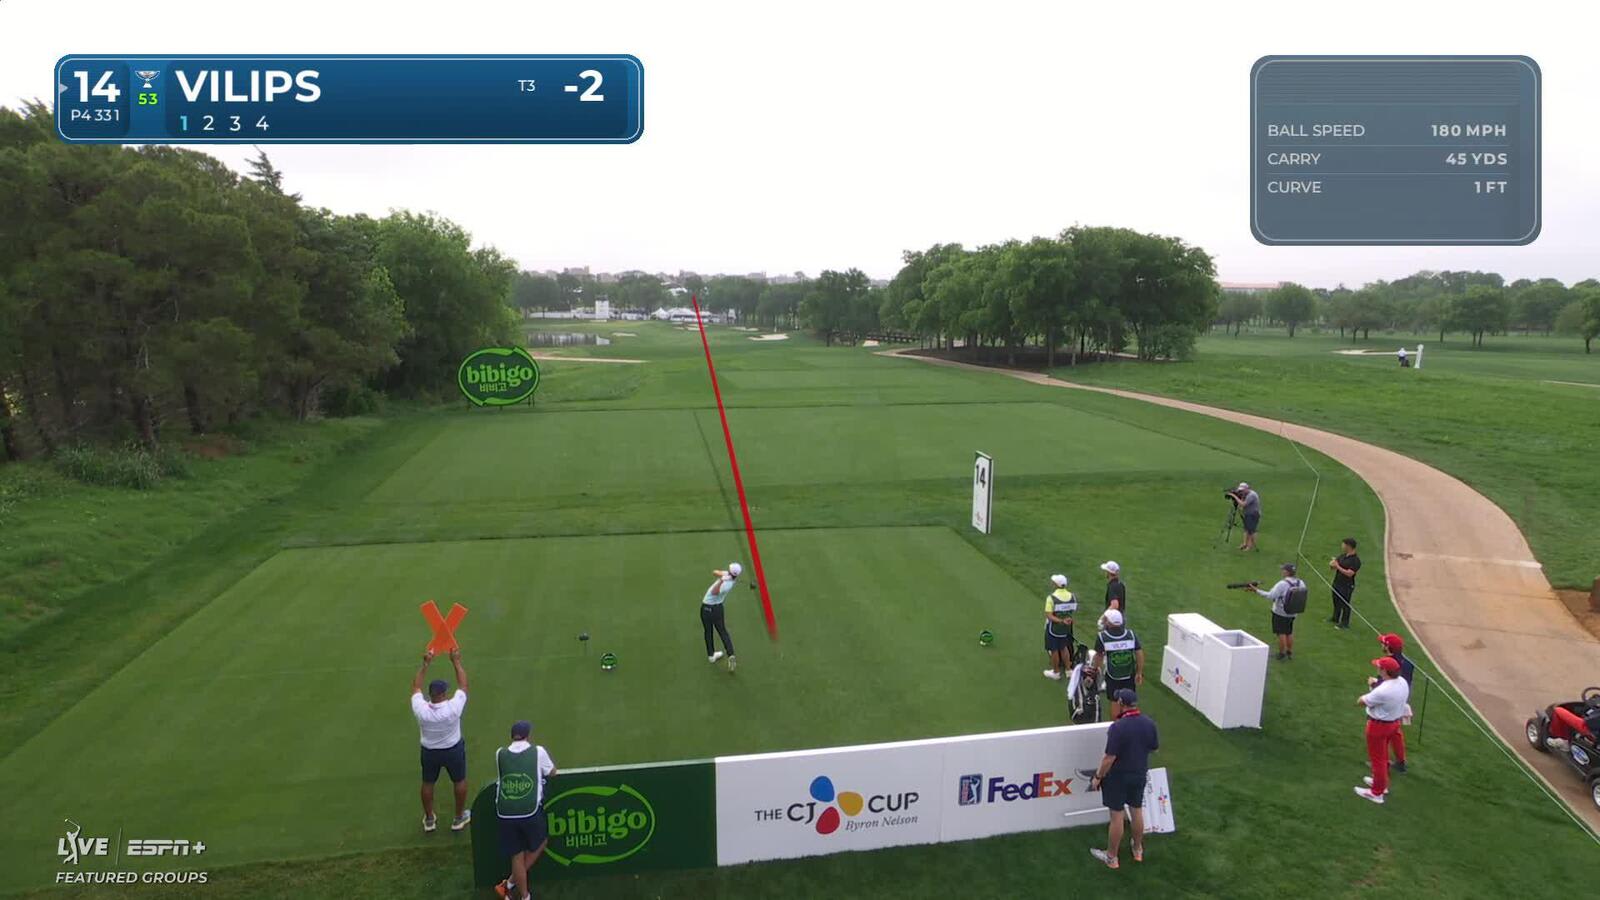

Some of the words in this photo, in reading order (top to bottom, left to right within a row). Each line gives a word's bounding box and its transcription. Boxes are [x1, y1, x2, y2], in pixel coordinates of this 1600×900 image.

[466, 363, 533, 388] bibigo
[480, 382, 507, 393] 비비고
[976, 464, 986, 488] 14
[987, 771, 1074, 803] FedEx
[754, 808, 783, 822] THE
[787, 801, 817, 825] CJ
[868, 791, 920, 814] CUP
[547, 806, 647, 839] bibigo
[845, 817, 879, 832] Byron
[882, 814, 919, 827] Nelson
[566, 833, 608, 849] 비비고
